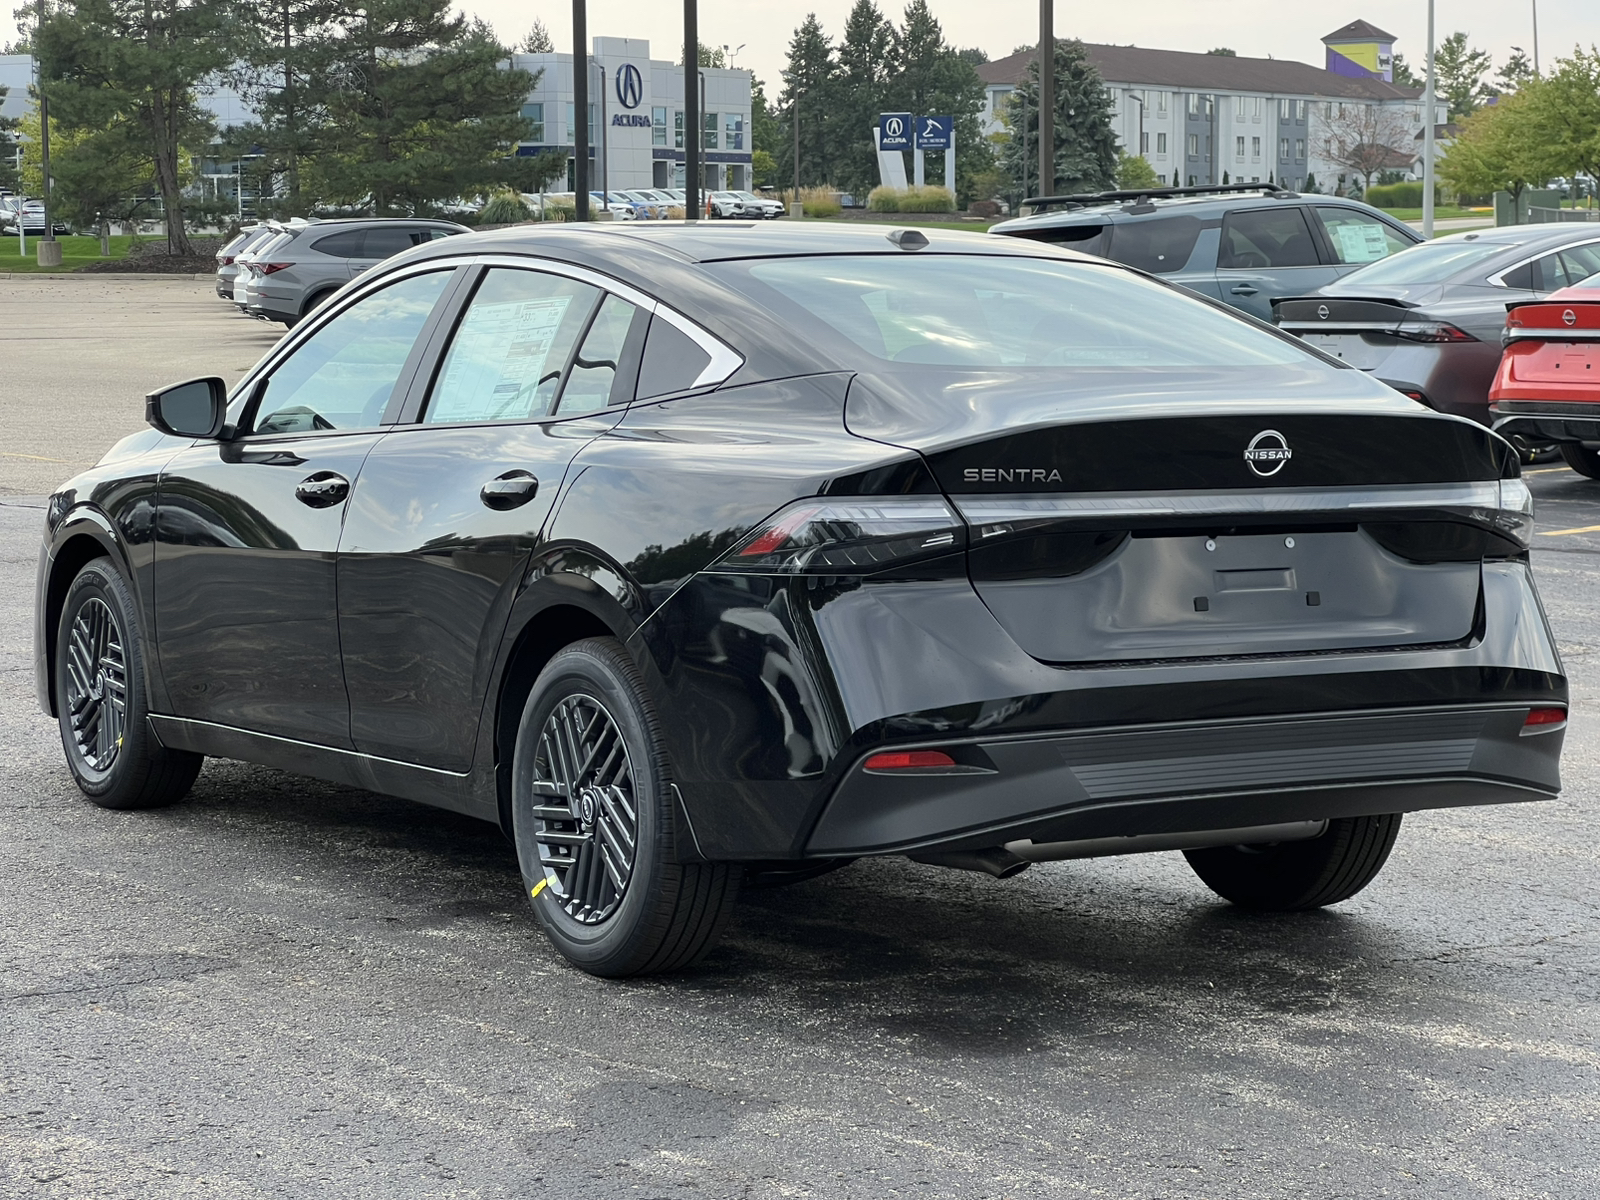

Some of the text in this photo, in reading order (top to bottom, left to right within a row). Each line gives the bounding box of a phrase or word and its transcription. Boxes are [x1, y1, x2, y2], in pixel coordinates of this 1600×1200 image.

[612, 114, 651, 127] ACURA
[1245, 450, 1292, 460] NISSAN
[963, 468, 1063, 482] SENTRA
